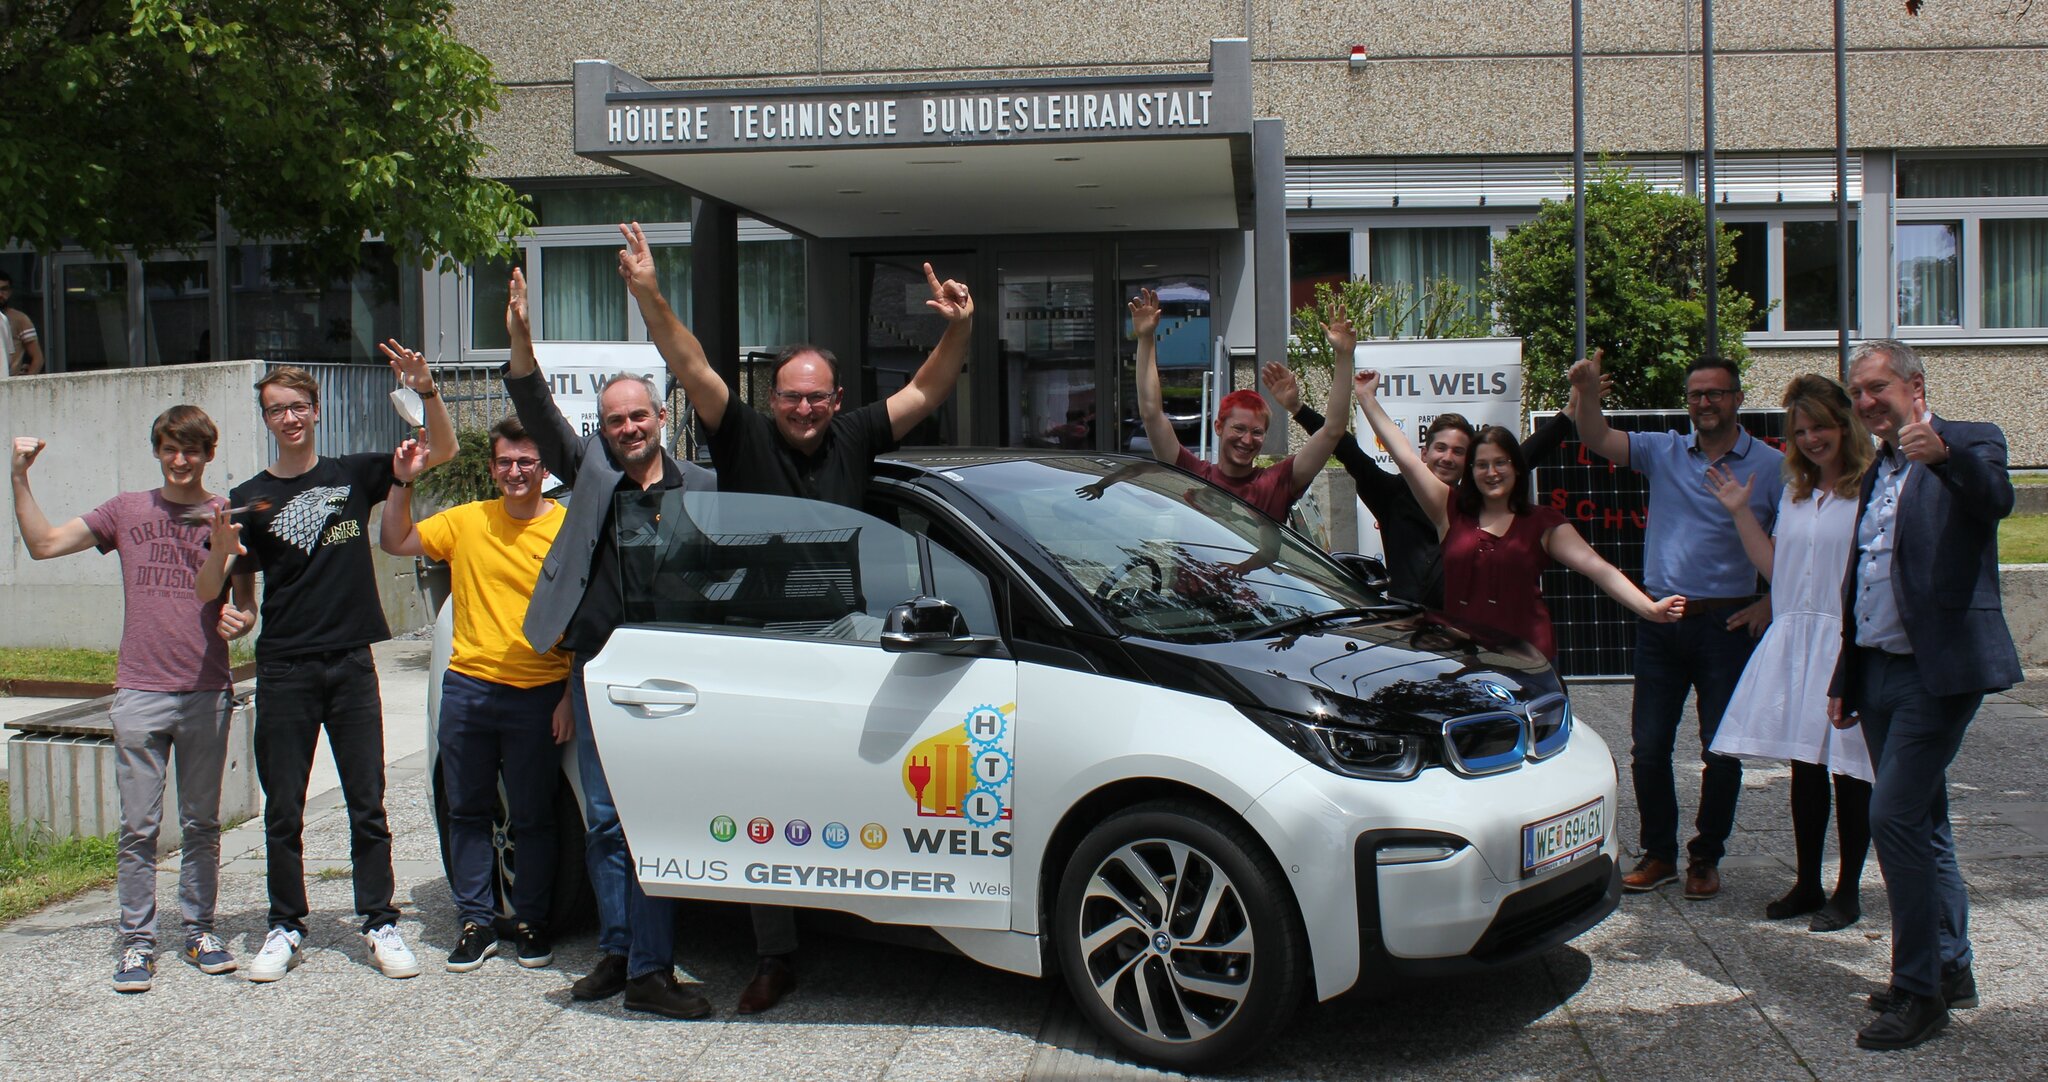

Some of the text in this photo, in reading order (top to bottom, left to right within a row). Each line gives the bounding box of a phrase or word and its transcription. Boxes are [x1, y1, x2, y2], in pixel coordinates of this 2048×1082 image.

[608, 90, 1213, 142] HÖHERE TECHNISCHE BUNDESLEHRANSTALT
[1375, 372, 1507, 397] HTL WELS
[1551, 487, 1649, 530] SCHU
[129, 519, 210, 546] ORIGINA
[136, 565, 196, 590] DIVISIO
[713, 820, 883, 843] MT ET IT MB CH
[902, 827, 1013, 858] WELS
[1537, 827, 1556, 859] WE
[1564, 816, 1586, 848] 694
[1588, 808, 1601, 839] GX
[638, 856, 1011, 896] HAUS GEYRHOFER Wels
